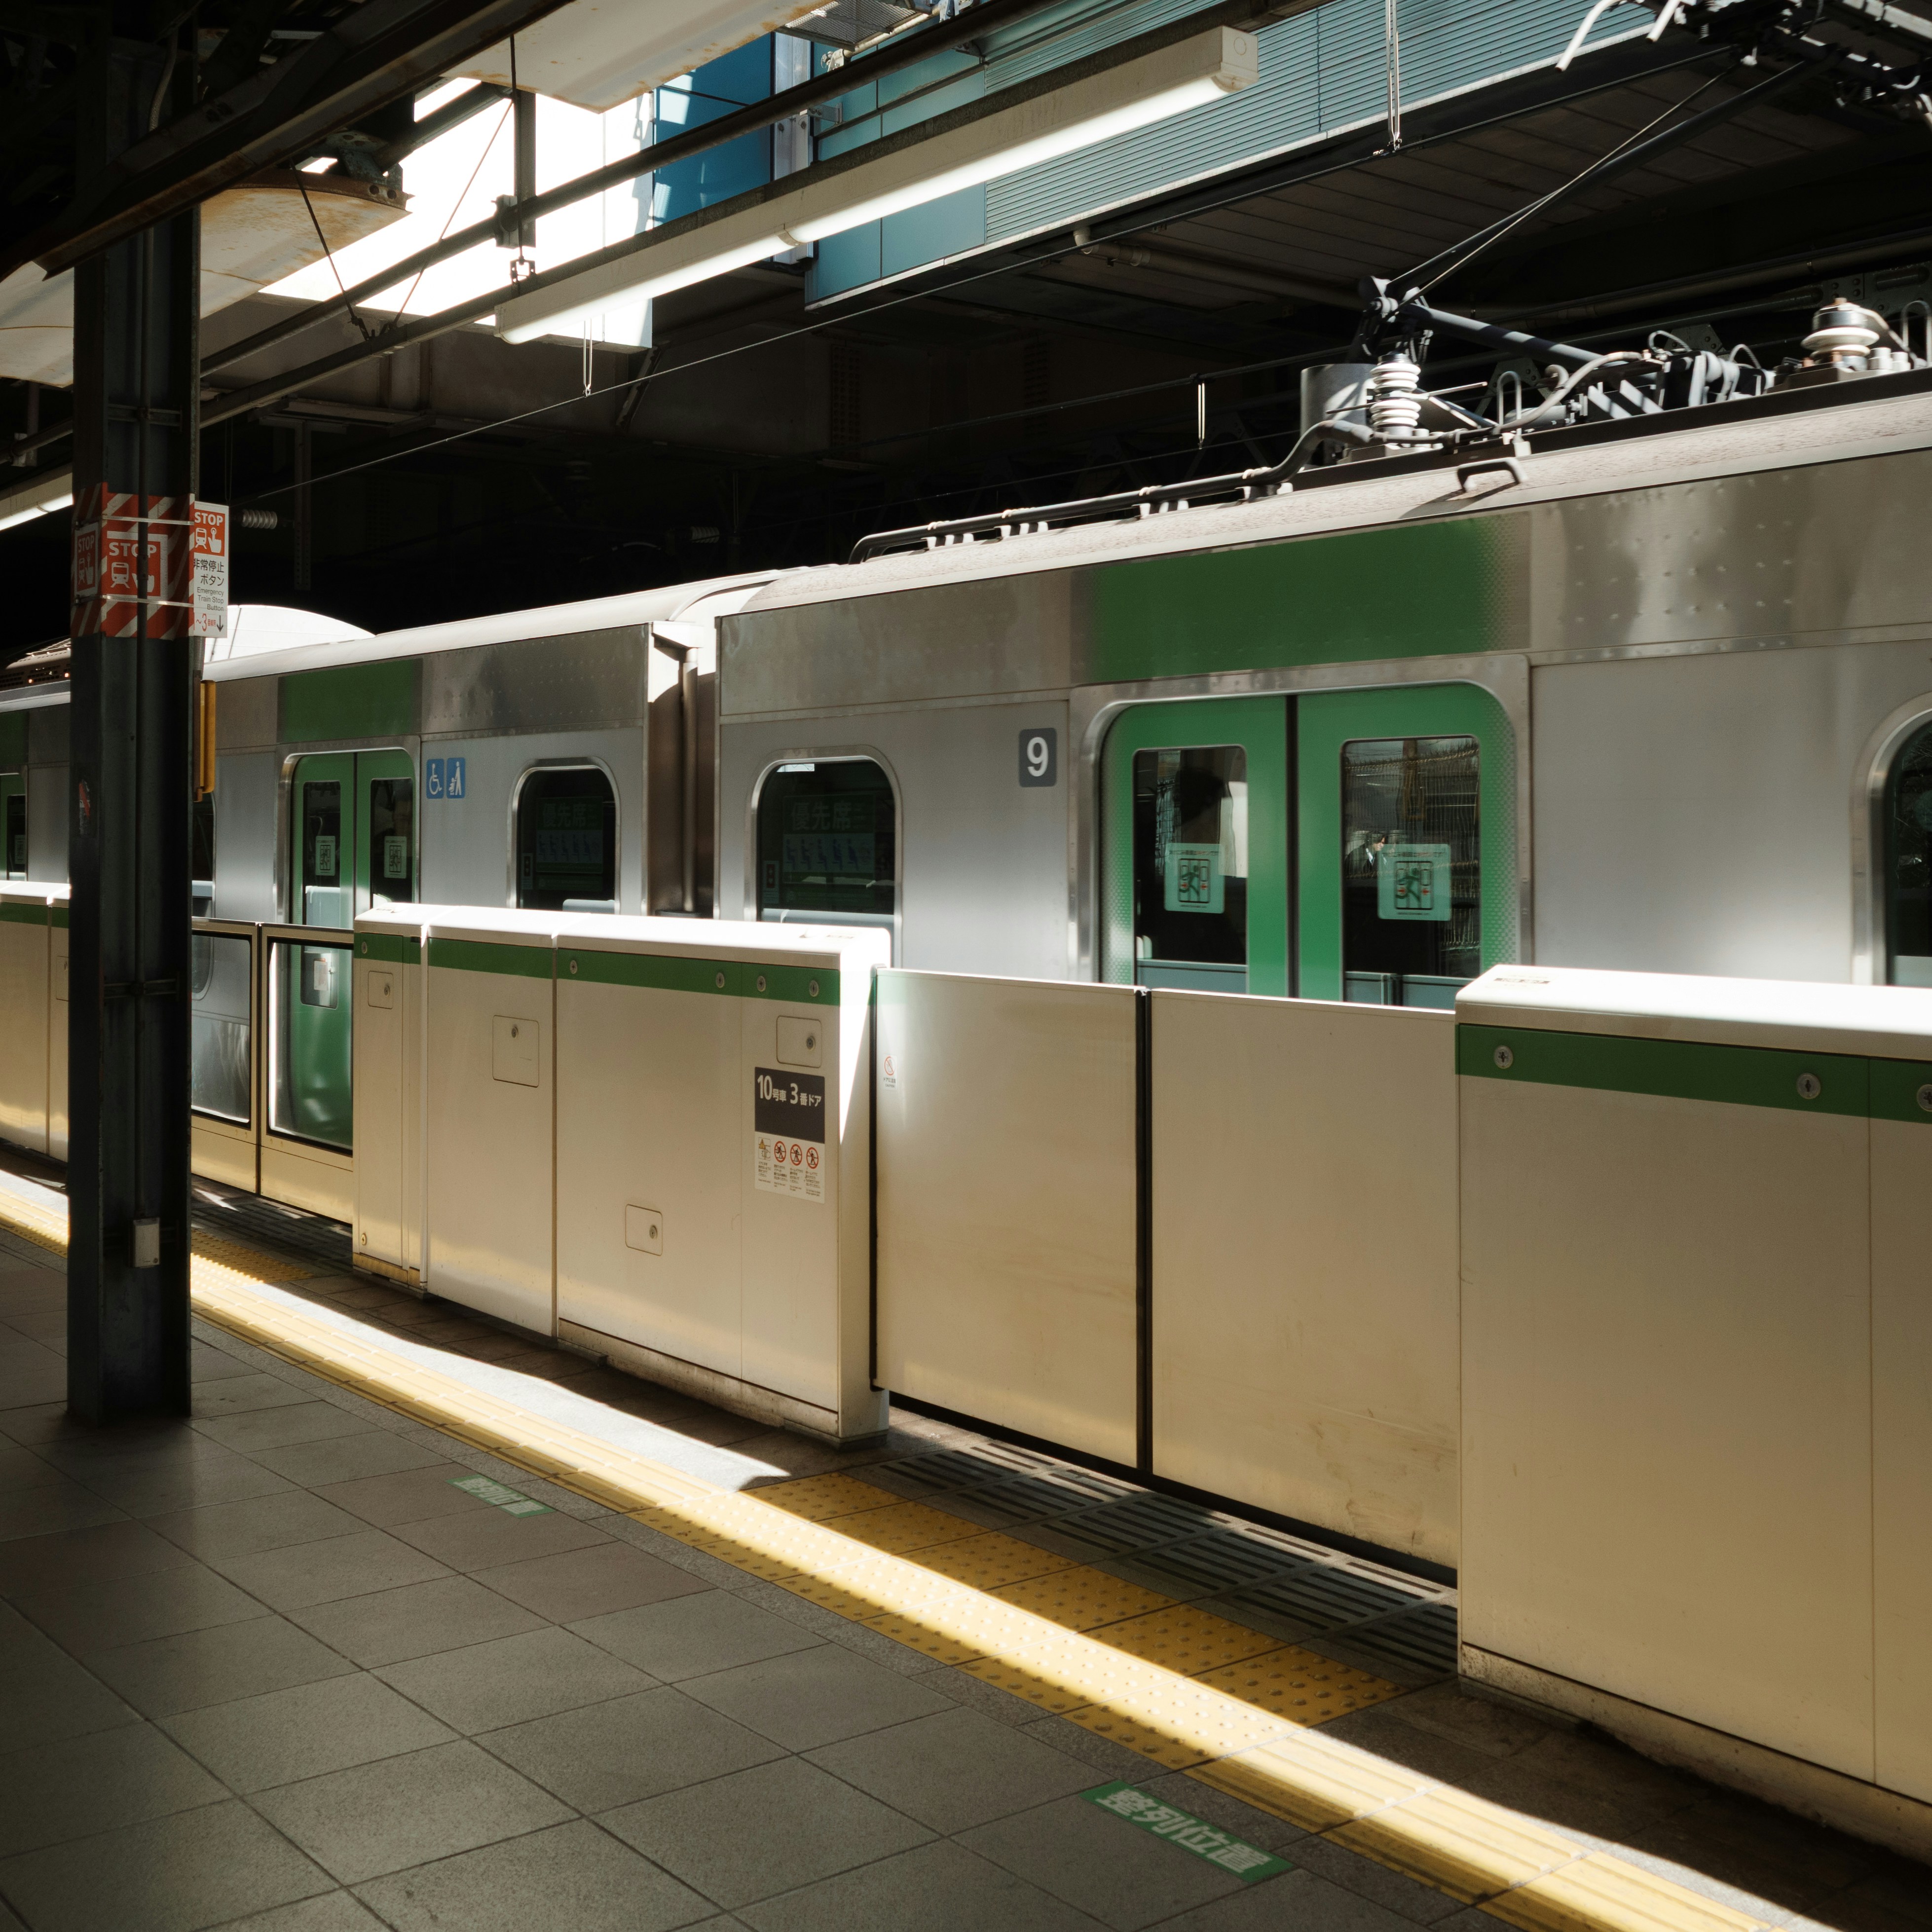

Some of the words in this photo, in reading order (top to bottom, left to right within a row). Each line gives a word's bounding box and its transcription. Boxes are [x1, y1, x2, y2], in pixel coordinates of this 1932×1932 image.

[194, 512, 223, 526] STOP
[78, 534, 95, 553] STOP
[193, 558, 224, 573] 非常停止
[200, 574, 224, 586] ボタン
[197, 587, 224, 597] Emergency
[1027, 737, 1049, 777] 9
[757, 1075, 787, 1102] 10号車
[790, 1083, 821, 1107] 3番ドア
[1096, 1789, 1272, 1873] 整列位置
